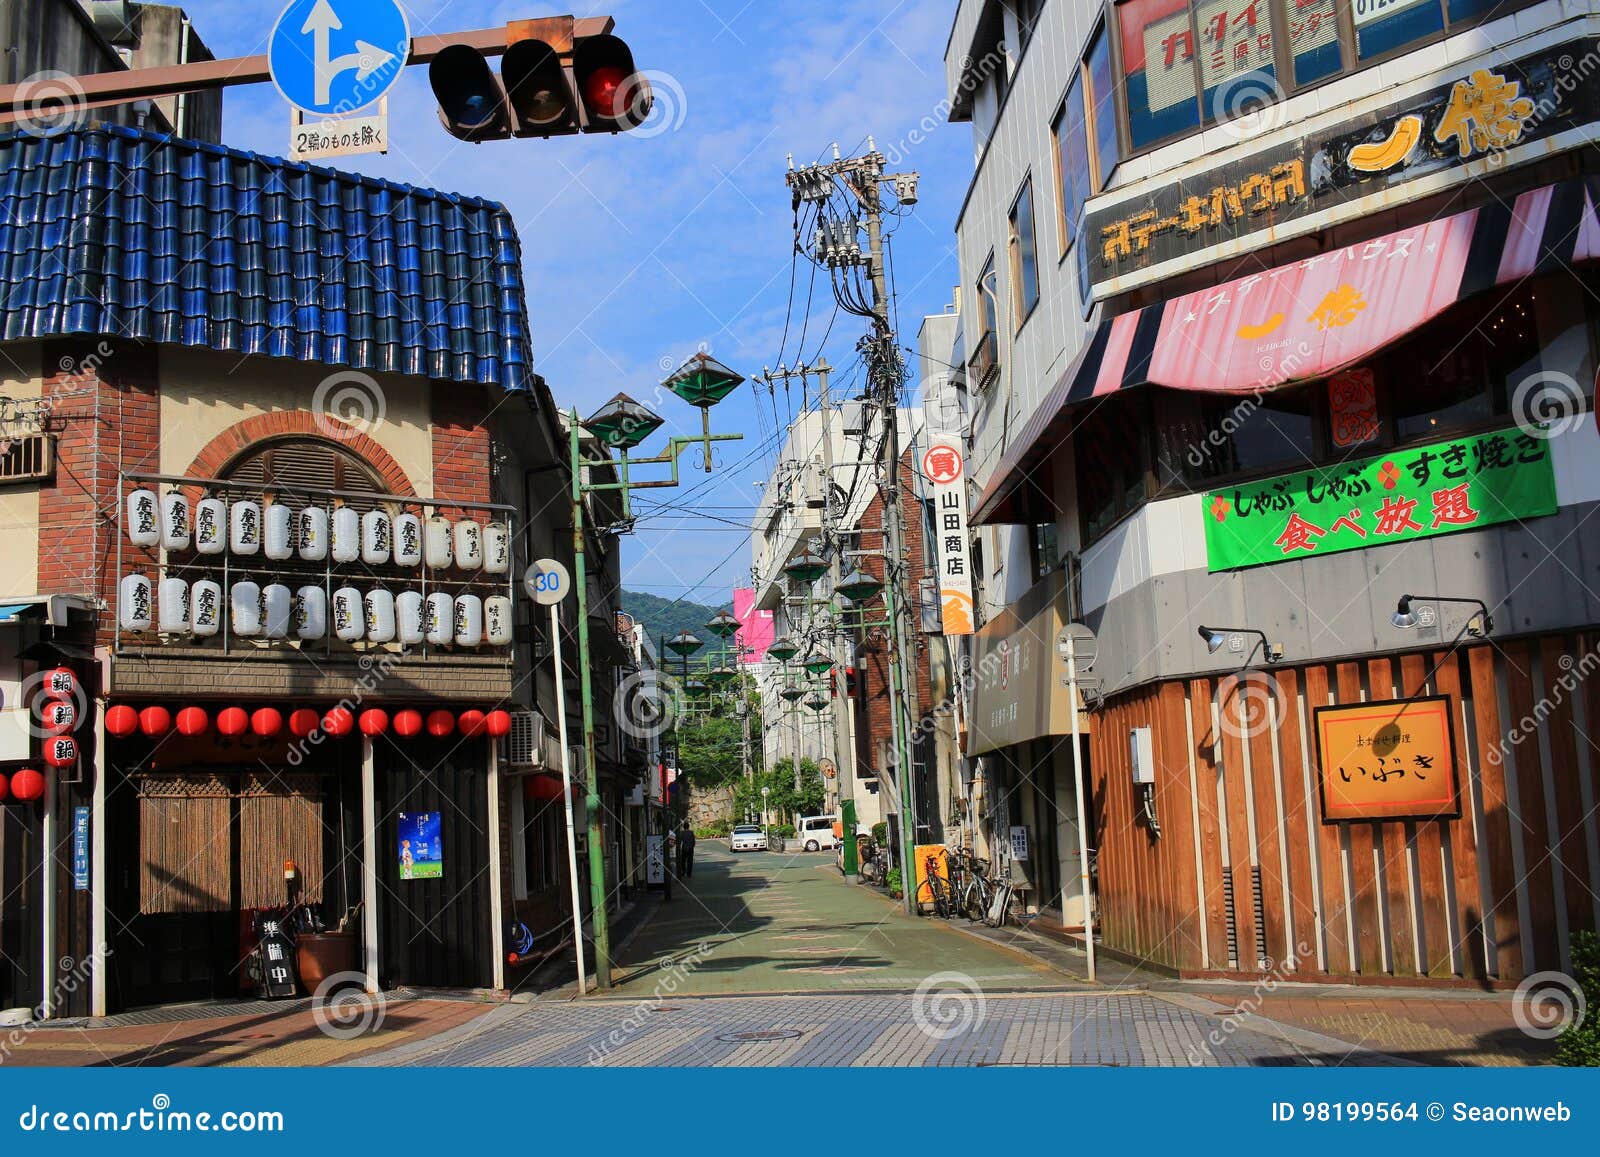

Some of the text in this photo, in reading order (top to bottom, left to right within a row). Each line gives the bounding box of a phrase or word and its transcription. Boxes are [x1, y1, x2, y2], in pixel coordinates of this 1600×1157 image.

[297, 125, 382, 153] 2輪のものを除く
[1407, 433, 1546, 487] すき焼き
[1275, 482, 1480, 553] 食べ放題
[941, 491, 964, 575] 山田商店
[535, 571, 559, 592] 30
[53, 673, 72, 692] 鍋
[55, 741, 74, 759] 鍋
[1339, 755, 1434, 783] いぶき
[263, 920, 287, 983] 準備中
